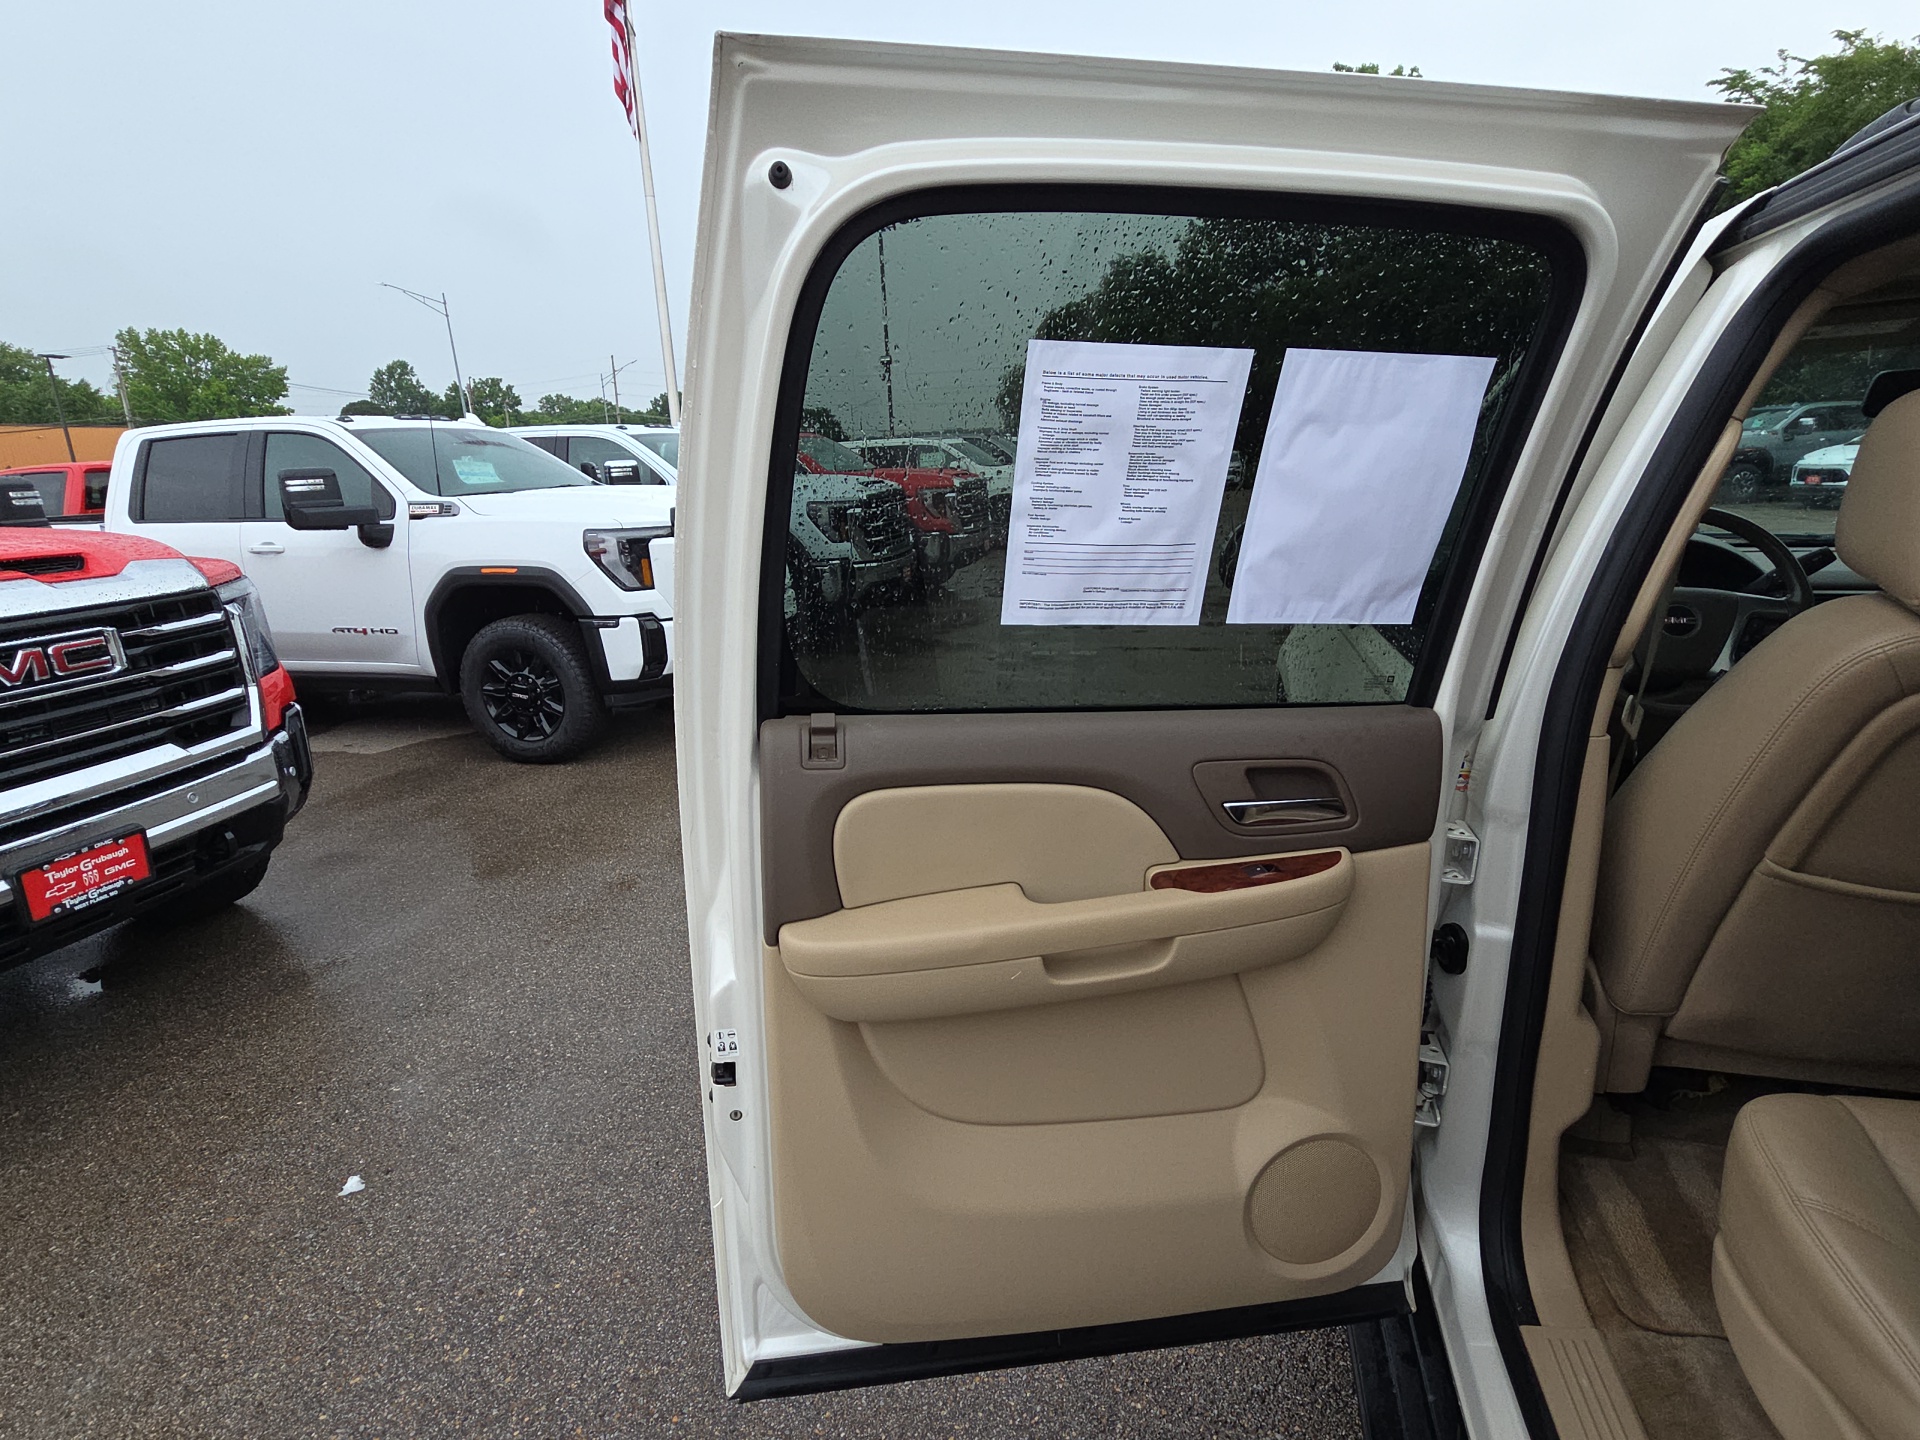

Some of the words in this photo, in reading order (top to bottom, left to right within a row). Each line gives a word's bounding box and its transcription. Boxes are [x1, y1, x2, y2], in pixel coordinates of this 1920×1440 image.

[332, 627, 368, 636] AT4
[0, 636, 113, 687] MC
[44, 864, 79, 884] Taylor
[80, 846, 129, 872] Grubaugh
[104, 859, 137, 876] GMC
[61, 893, 88, 909] Taylor
[88, 879, 125, 899] Grubaugh
[73, 901, 90, 911] WEST
